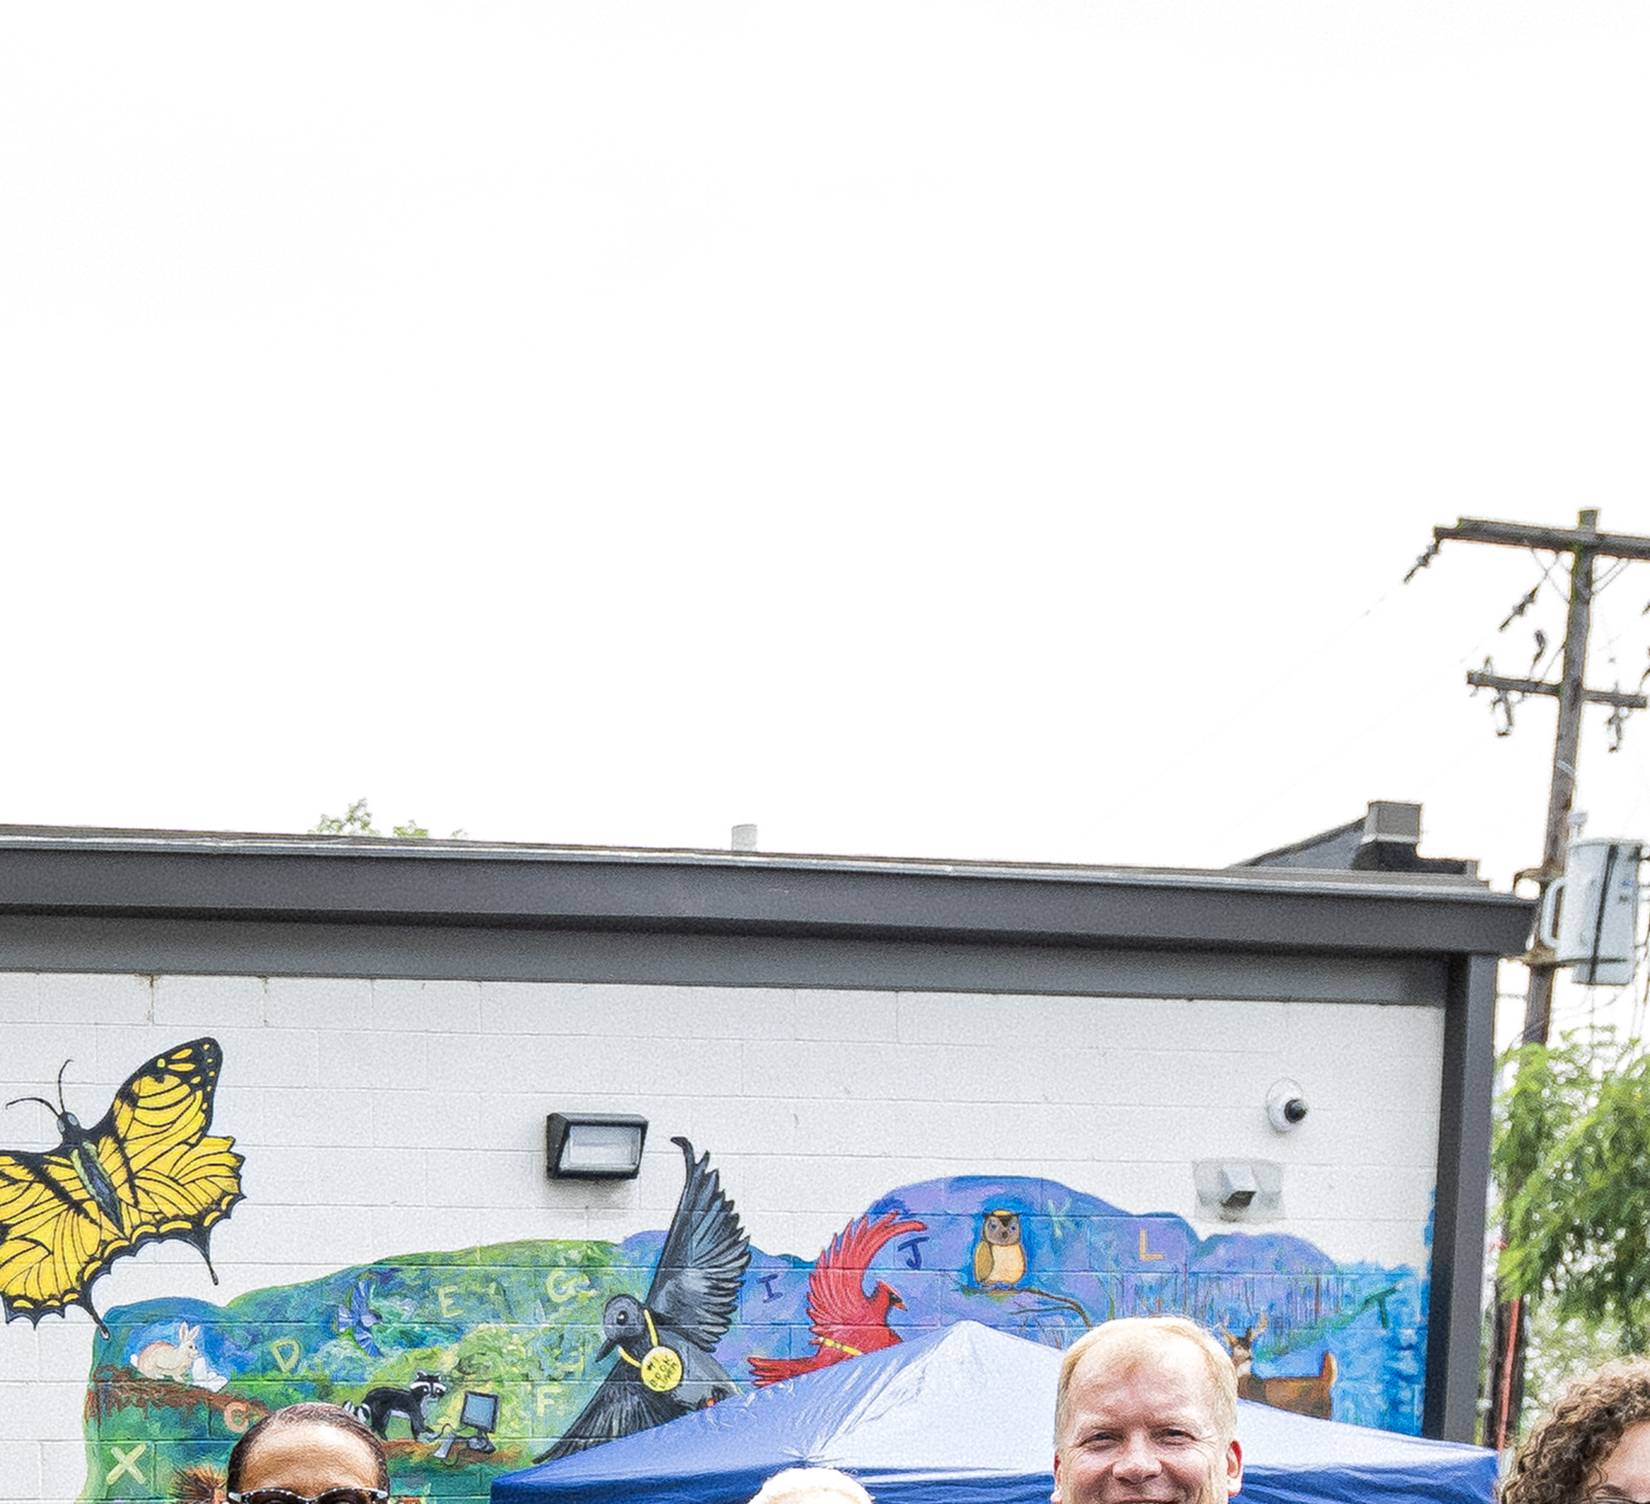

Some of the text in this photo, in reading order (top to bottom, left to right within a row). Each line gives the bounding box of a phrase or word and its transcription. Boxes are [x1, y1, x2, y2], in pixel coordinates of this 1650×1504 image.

[897, 1235, 931, 1271] J
[1138, 1228, 1165, 1261] L
[437, 1285, 464, 1318] E
[546, 1267, 578, 1303] G
[755, 1273, 783, 1303] I
[270, 1337, 301, 1373] D
[649, 1355, 672, 1389] BOOK
[223, 1401, 249, 1433] C
[536, 1385, 563, 1417] F
[105, 1442, 147, 1485] X
